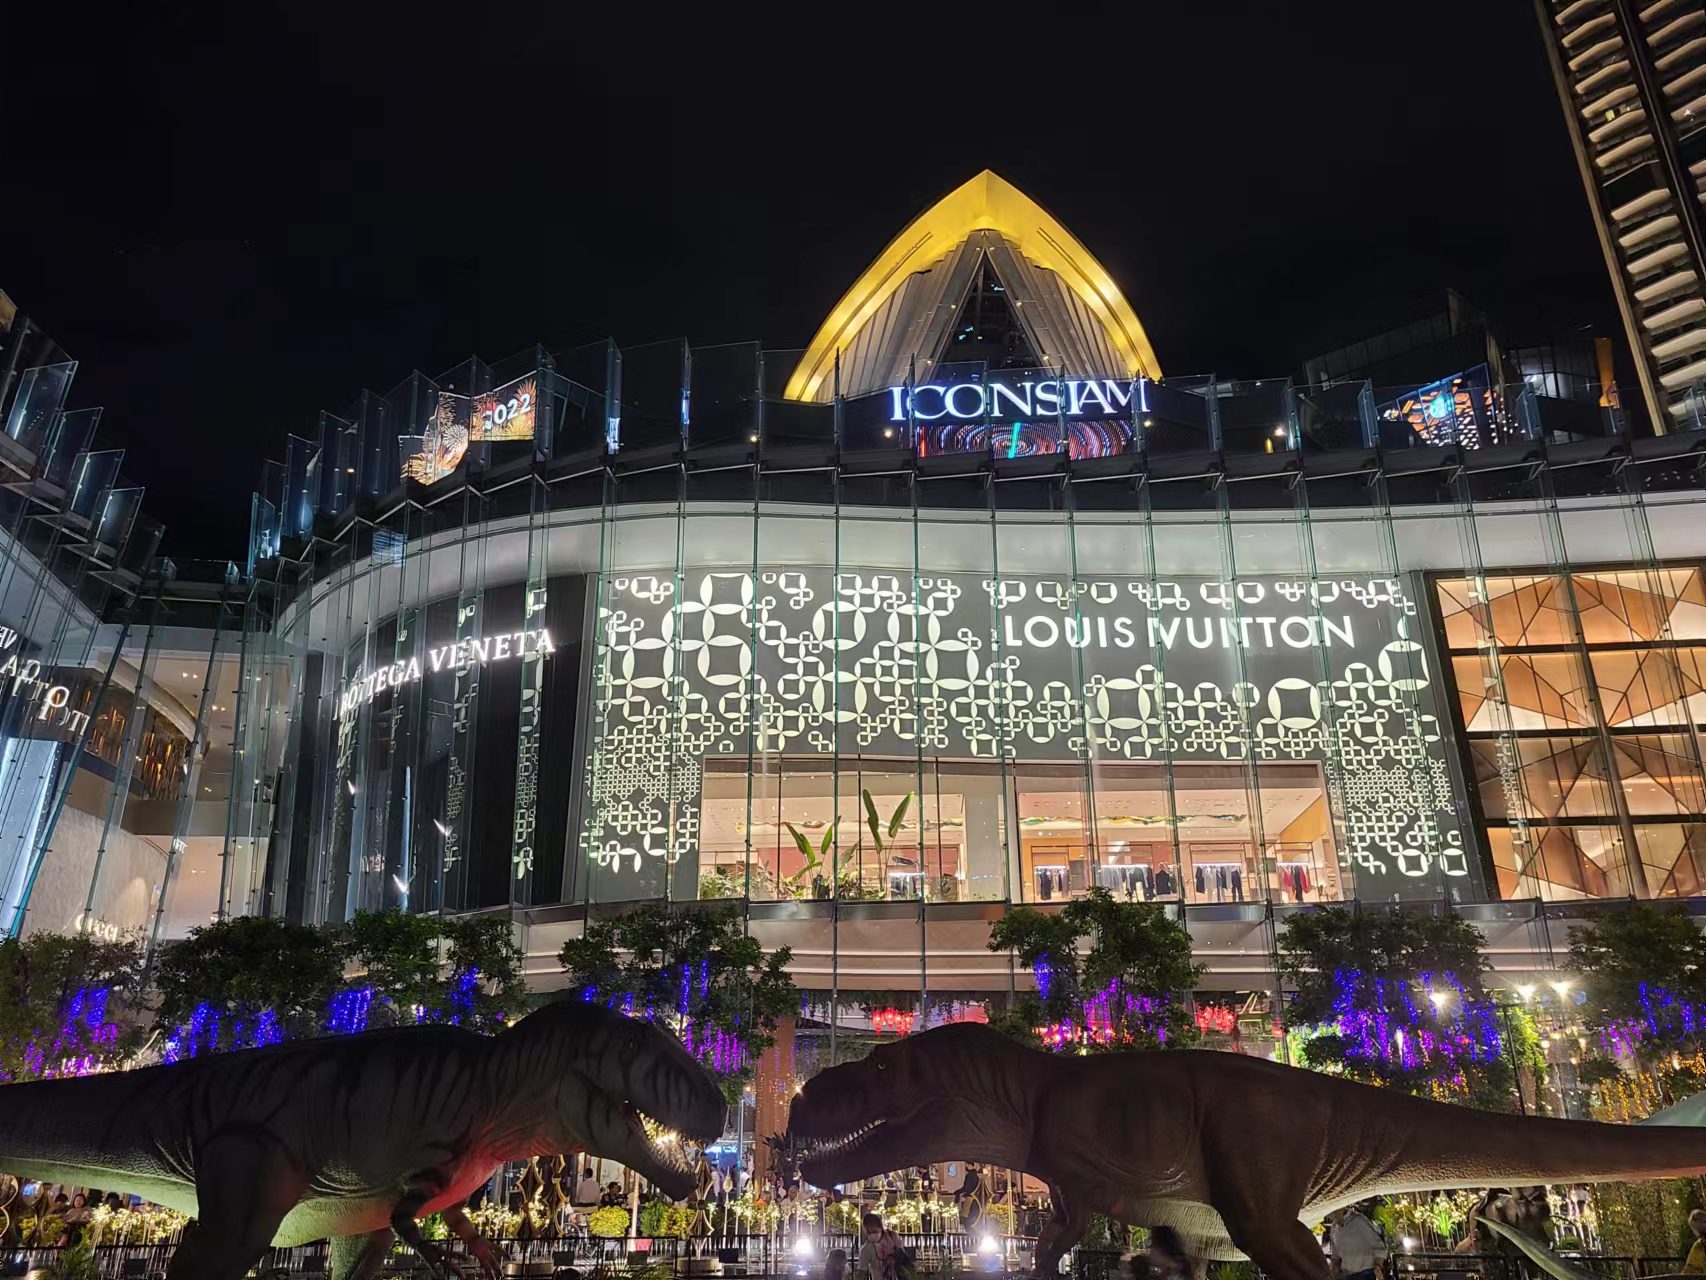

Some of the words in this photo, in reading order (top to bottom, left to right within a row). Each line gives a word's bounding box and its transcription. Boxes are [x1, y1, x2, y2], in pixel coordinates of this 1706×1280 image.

[483, 393, 531, 430] 2022
[889, 378, 1152, 421] ICONSIAM
[429, 628, 556, 672] VENETA
[1004, 615, 1136, 648] LOUIS
[1152, 615, 1355, 649] VUITTON
